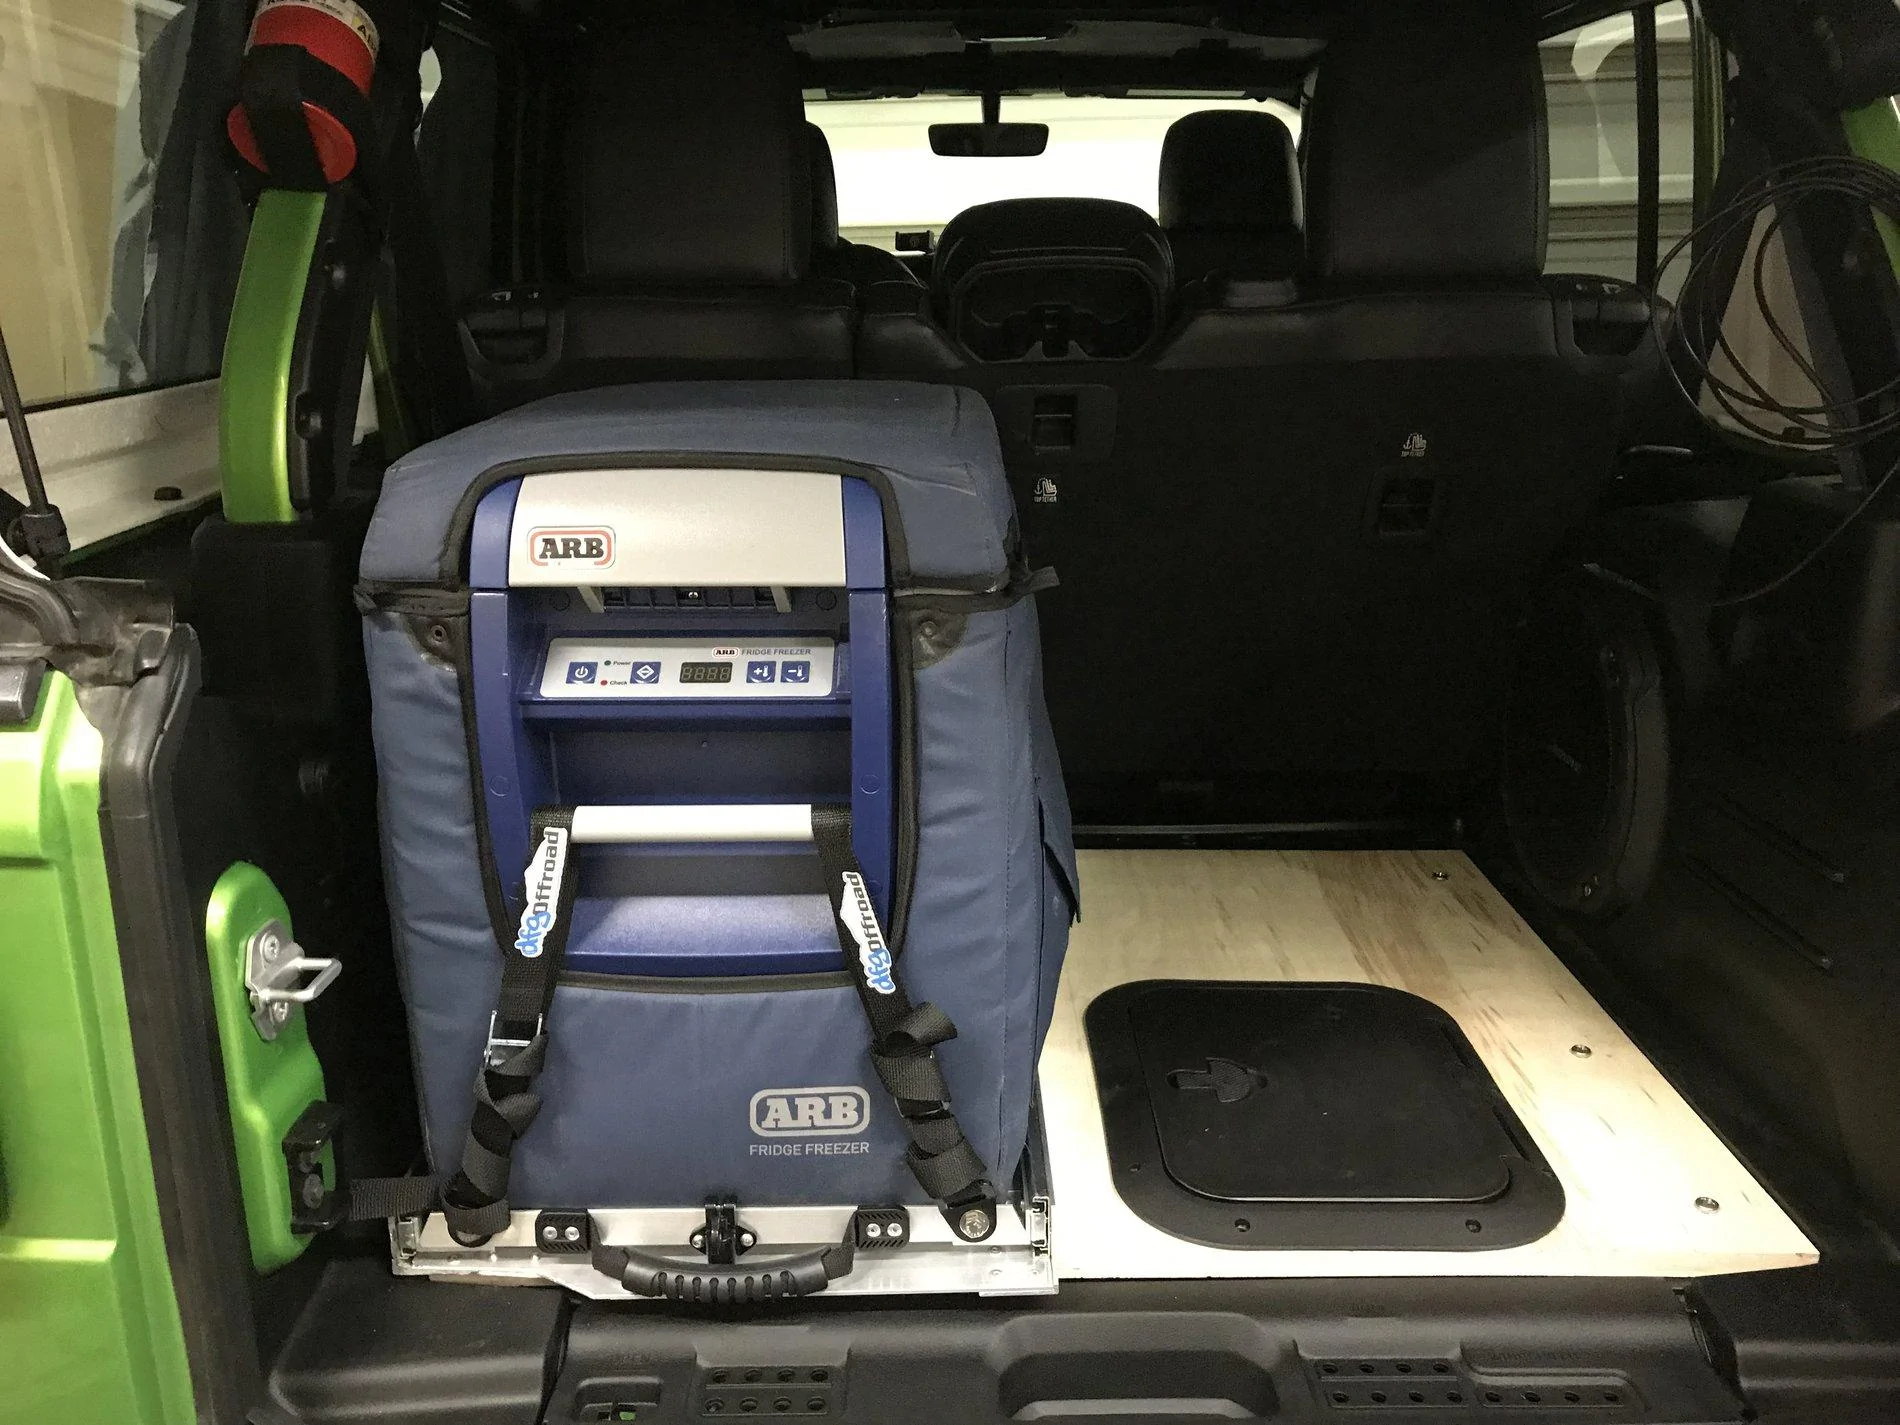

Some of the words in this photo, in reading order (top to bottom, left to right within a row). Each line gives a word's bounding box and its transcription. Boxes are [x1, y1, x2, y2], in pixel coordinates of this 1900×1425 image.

[539, 538, 604, 559] ARB
[762, 1096, 859, 1128] ARB
[749, 1144, 802, 1156] FRIDGE
[805, 1141, 870, 1155] FREEZER
